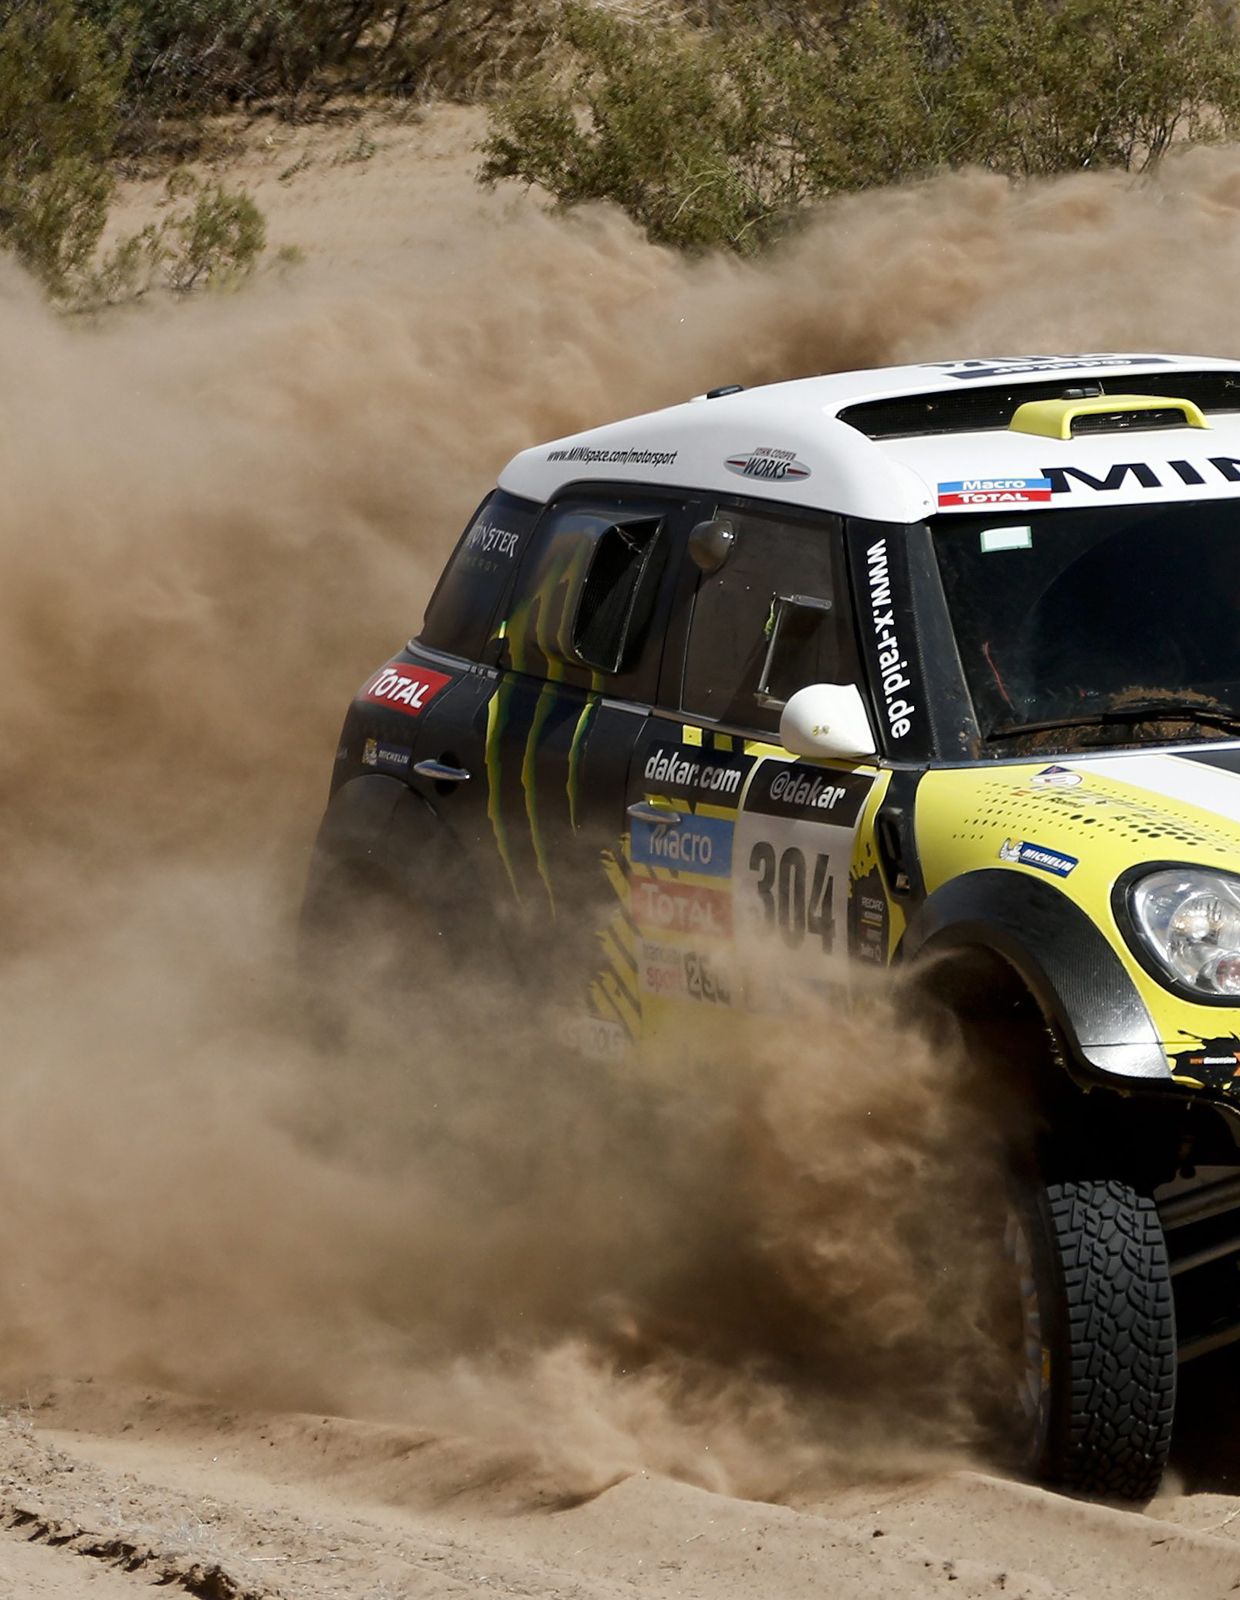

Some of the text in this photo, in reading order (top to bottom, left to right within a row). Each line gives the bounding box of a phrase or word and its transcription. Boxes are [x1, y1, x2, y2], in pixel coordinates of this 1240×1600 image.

[546, 447, 678, 468] www.MINIspace.com/motorsport
[744, 457, 791, 479] WORKS
[959, 491, 1030, 503] TOTAL
[962, 476, 1026, 491] Macro
[866, 538, 915, 739] www.x-raid.de
[368, 668, 430, 709] TOTAL
[378, 749, 409, 764] MICHELIN
[644, 749, 742, 794] dakar.com
[769, 770, 846, 810] @dakar
[650, 824, 712, 865] Macro
[1022, 848, 1075, 872] MICHELIN
[640, 883, 726, 934] TOTAL
[749, 840, 837, 955] 304
